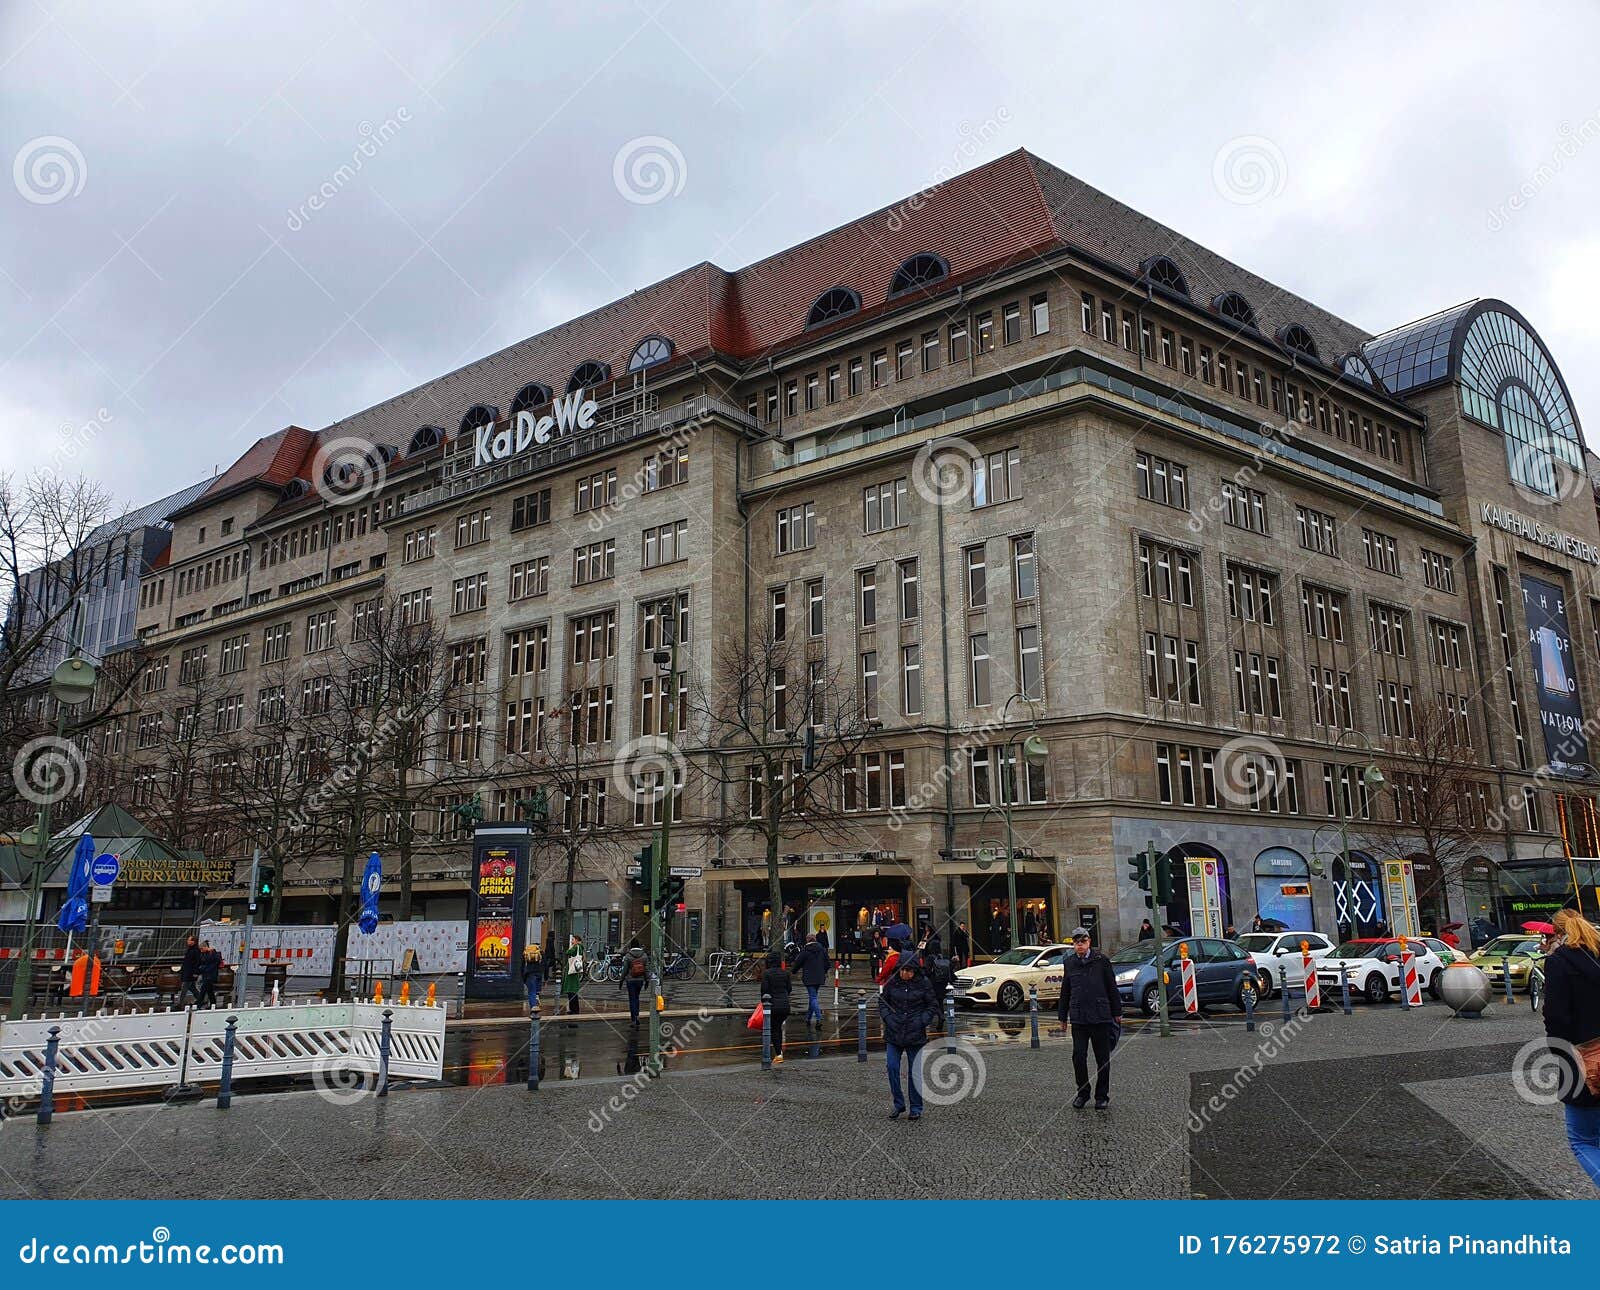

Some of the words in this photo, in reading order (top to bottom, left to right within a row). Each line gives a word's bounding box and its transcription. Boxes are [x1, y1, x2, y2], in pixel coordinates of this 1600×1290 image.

[475, 388, 600, 467] KaDeWe
[1480, 502, 1543, 543] KAUFHAUS
[1555, 529, 1600, 566] WESTENS
[1540, 710, 1583, 733] VATION
[177, 860, 232, 869] BERLINER
[480, 877, 514, 886] AFRIKA!
[479, 886, 513, 895] AFRIKA!
